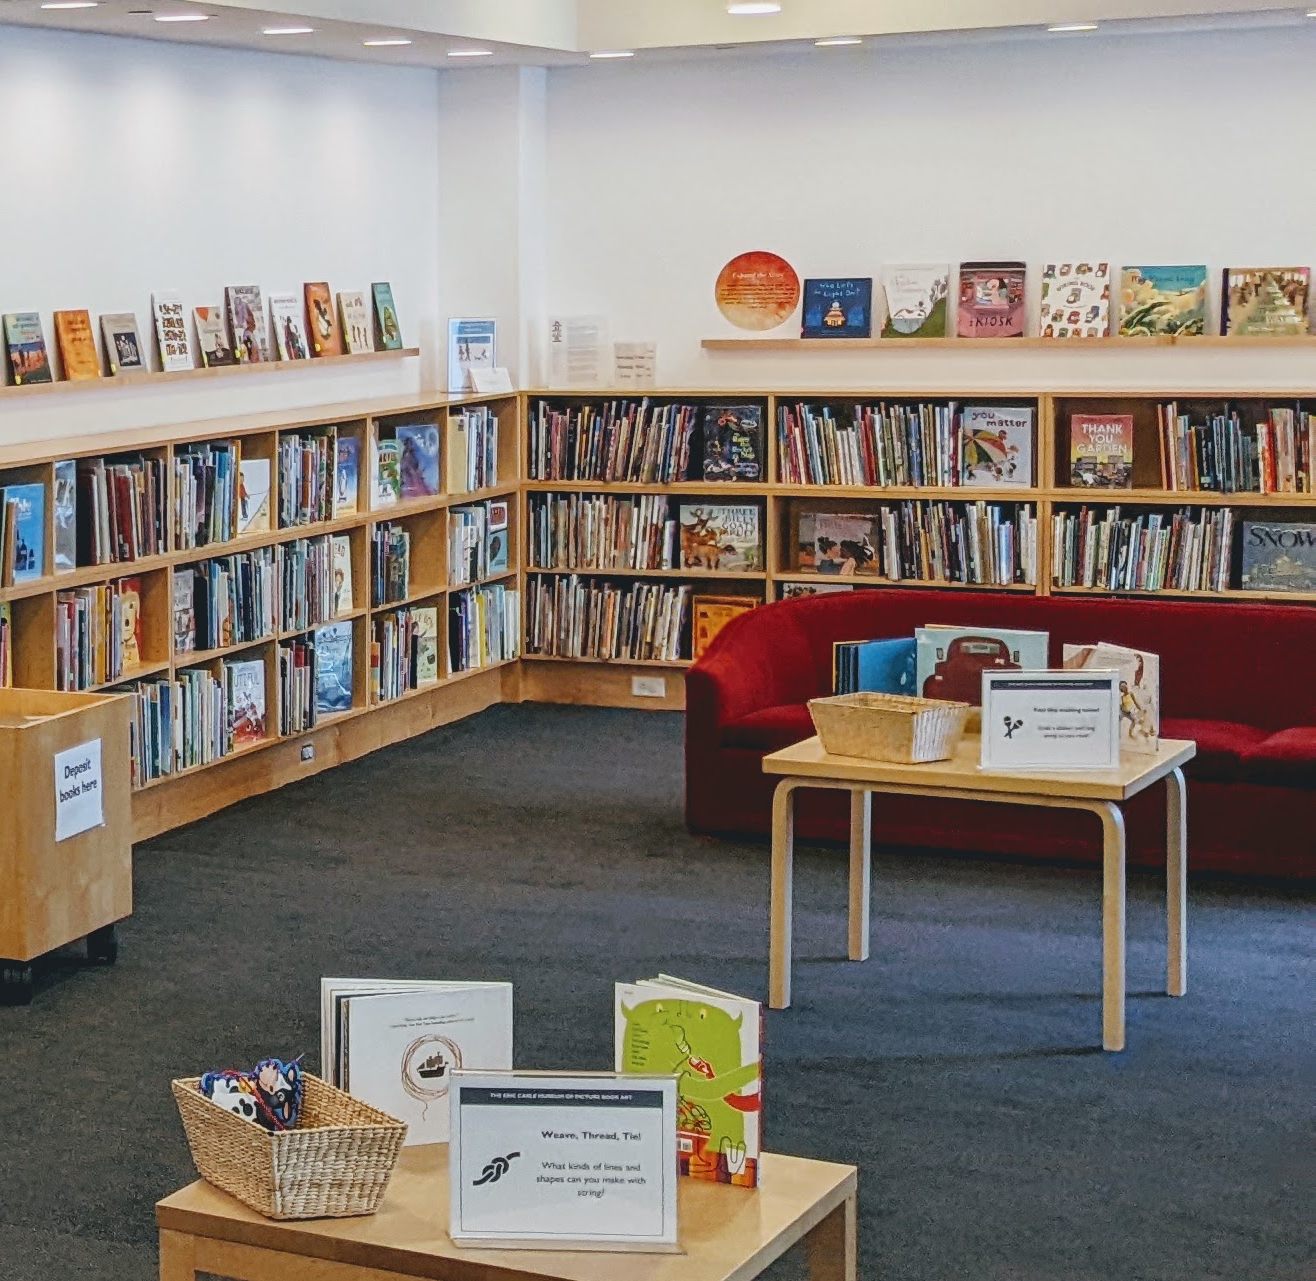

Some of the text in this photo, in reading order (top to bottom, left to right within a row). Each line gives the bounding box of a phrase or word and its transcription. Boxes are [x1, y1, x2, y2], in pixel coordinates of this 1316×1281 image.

[976, 316, 1014, 328] KIOSK
[971, 411, 996, 420] you
[986, 420, 1028, 428] matter
[1081, 423, 1123, 434] THANK
[1088, 434, 1114, 443] YOU
[1076, 443, 1128, 453] GARDEN
[64, 757, 92, 780] Deposit
[59, 779, 98, 803] books here
[541, 1131, 642, 1141] Weave, Thread, Tie!
[541, 1161, 566, 1170] What
[568, 1162, 590, 1170] kinds
[604, 1163, 623, 1171] lines
[536, 1175, 565, 1185] shapes
[584, 1177, 600, 1185] you
[602, 1176, 625, 1184] make
[627, 1177, 647, 1185] with
